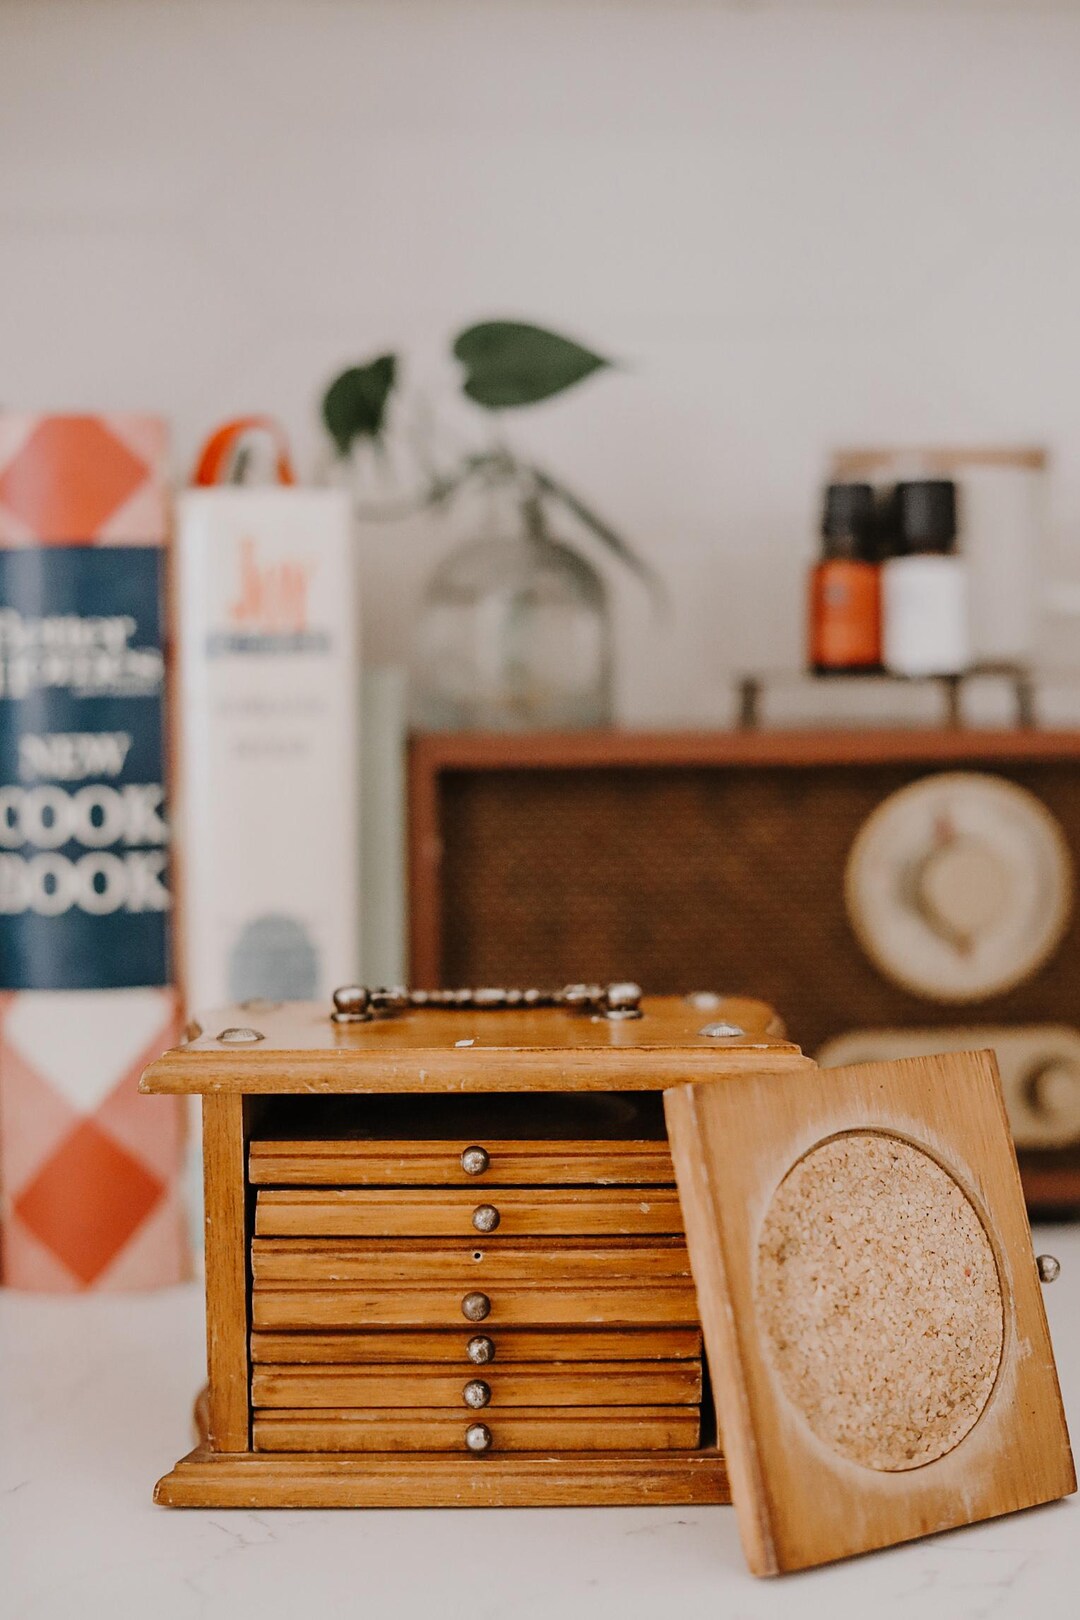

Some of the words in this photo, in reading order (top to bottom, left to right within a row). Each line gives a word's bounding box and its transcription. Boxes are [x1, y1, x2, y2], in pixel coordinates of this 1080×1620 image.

[19, 731, 132, 780] NEW
[0, 784, 168, 849] COOK
[0, 851, 169, 915] BOOK
